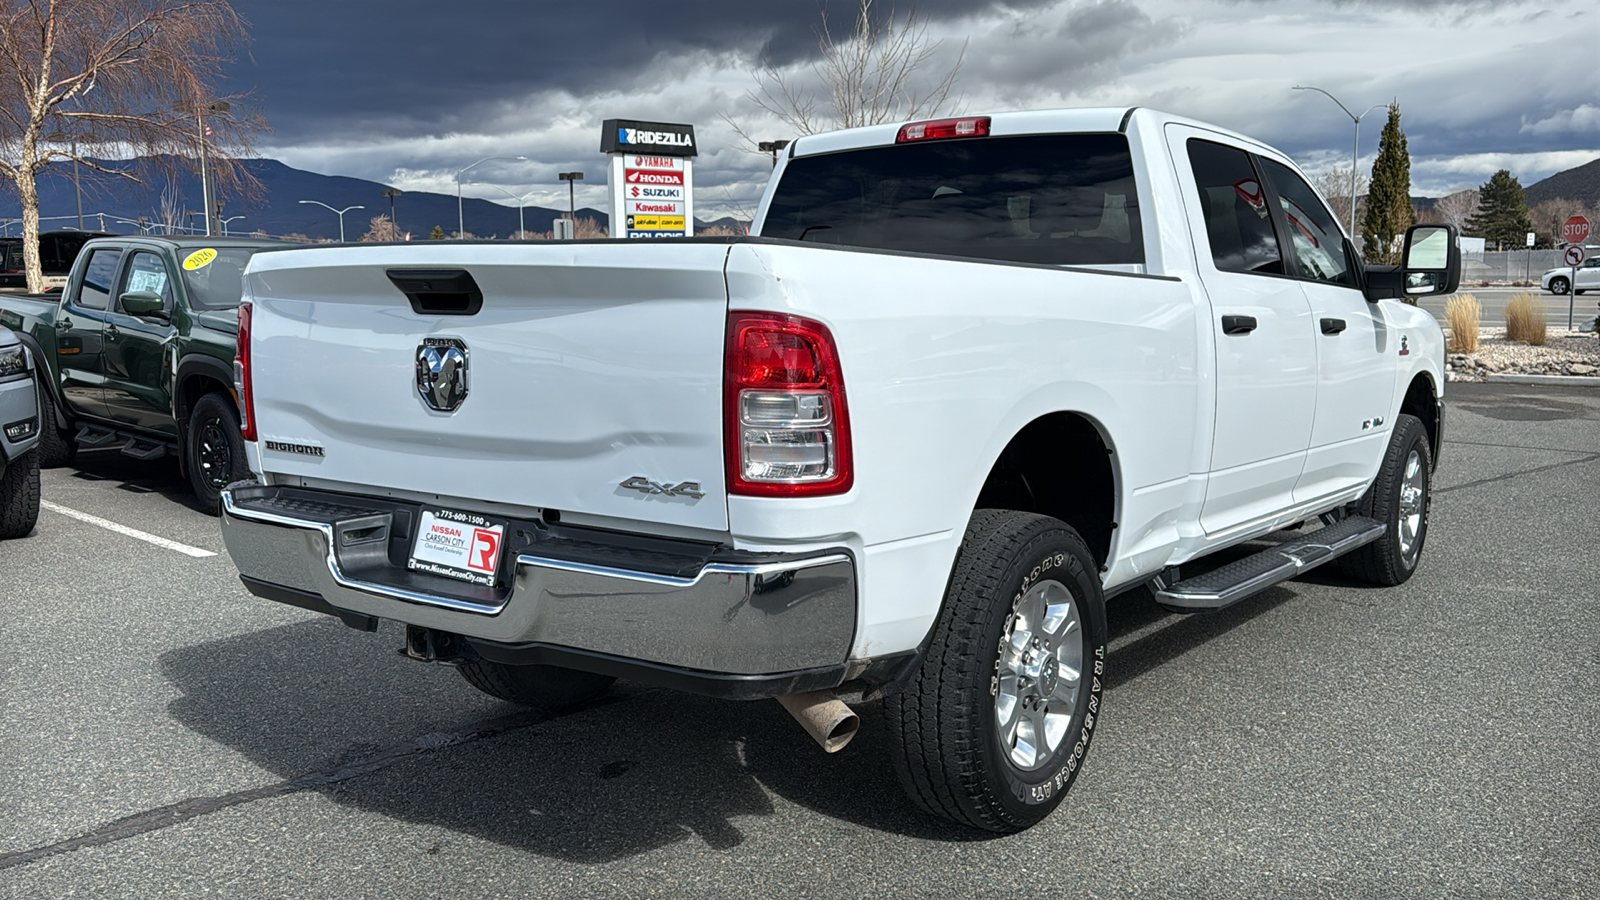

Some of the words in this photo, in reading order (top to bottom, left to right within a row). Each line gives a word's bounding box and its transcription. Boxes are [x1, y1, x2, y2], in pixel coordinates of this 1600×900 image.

[637, 130, 692, 147] RIDEZILLA
[644, 156, 674, 168] YAMAHA
[639, 174, 681, 184] HONDA
[643, 188, 679, 197] SUZUKI
[635, 203, 676, 213] Kawasaki
[1564, 224, 1588, 235] STOP
[188, 250, 212, 267] 2026
[440, 510, 485, 525] 775-600-1500
[431, 525, 462, 537] NISSAN
[425, 532, 451, 545] CARSON
[451, 537, 465, 547] CITY
[415, 562, 487, 583] www.NissanCarsonCity.com
[1055, 645, 1104, 790] TRANSFORCE
